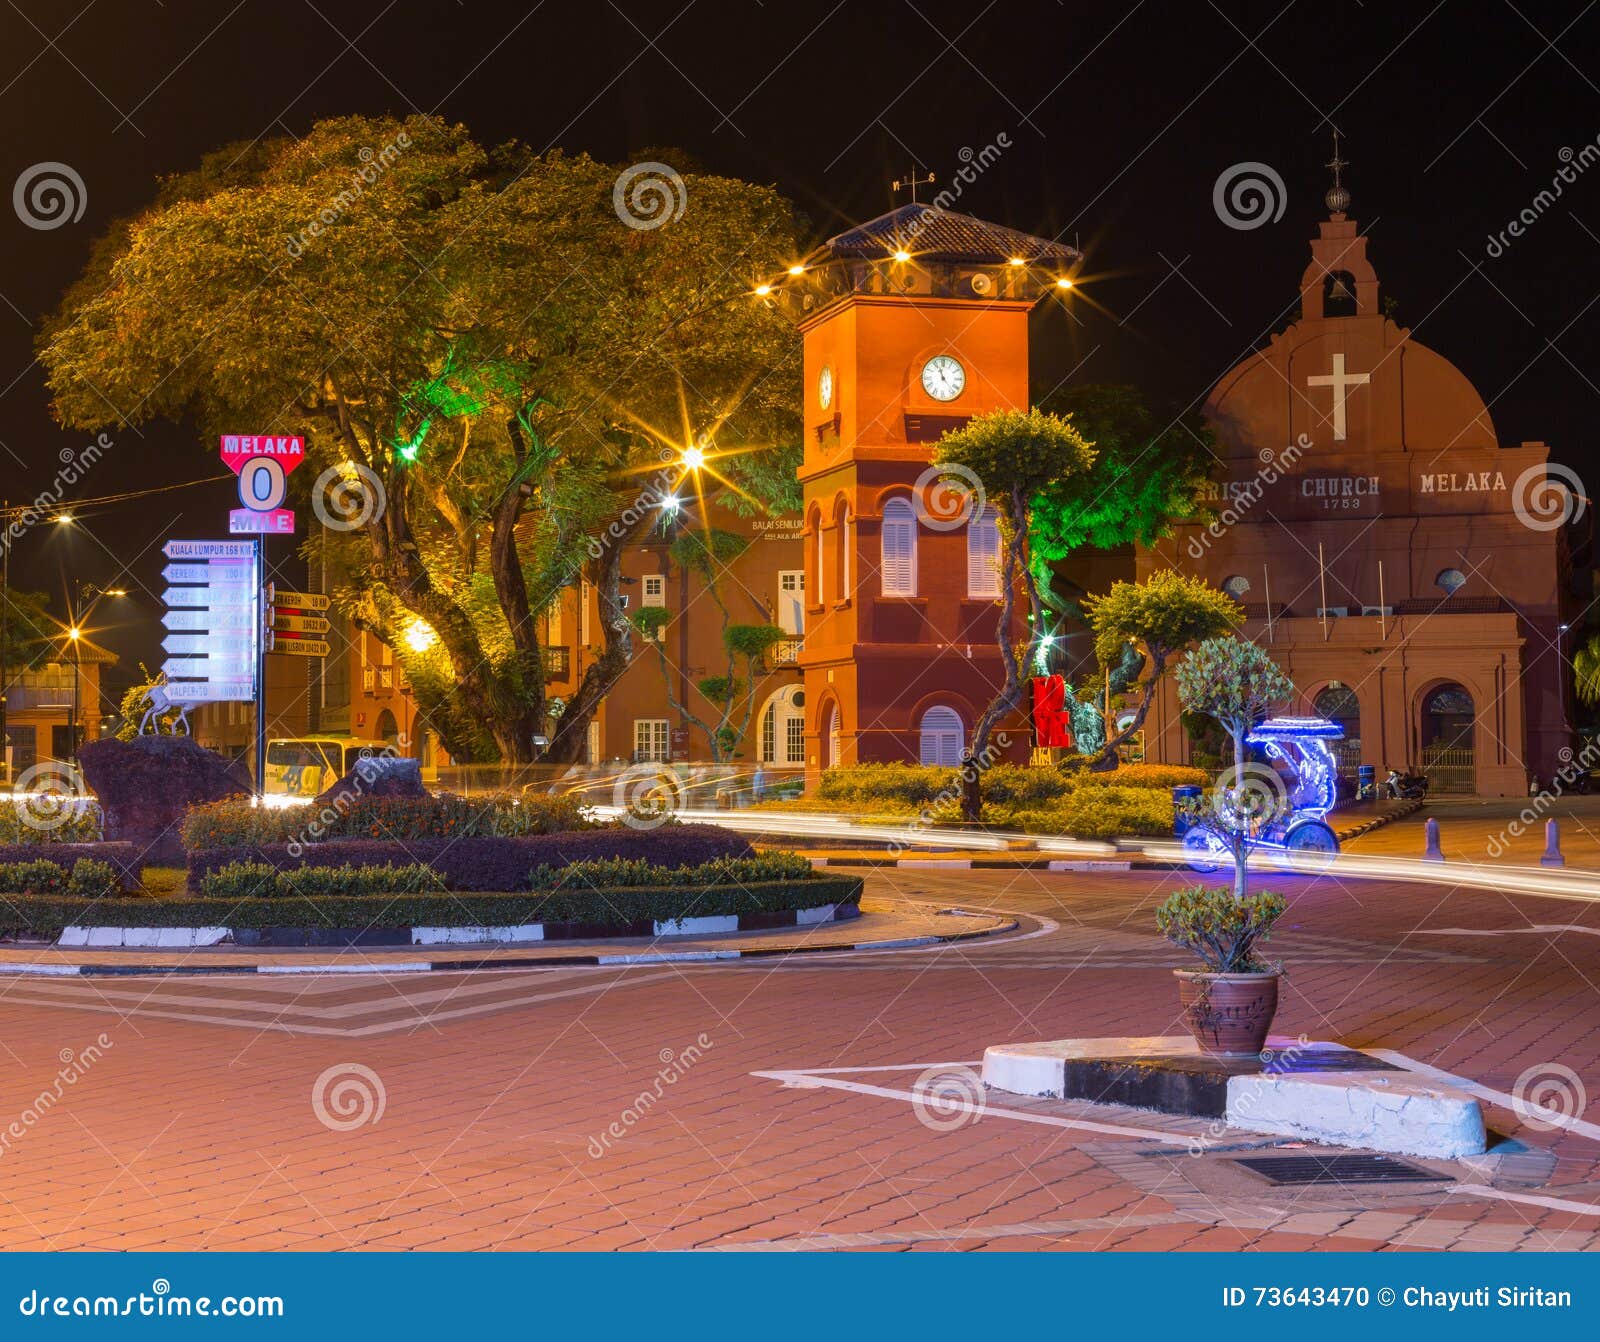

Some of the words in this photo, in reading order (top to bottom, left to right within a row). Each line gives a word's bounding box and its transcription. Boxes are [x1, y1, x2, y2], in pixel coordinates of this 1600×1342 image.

[224, 437, 301, 454] MELAKA
[1302, 477, 1380, 497] CHURCH
[1420, 472, 1507, 493] MELAKA
[234, 515, 289, 531] MILE
[170, 545, 193, 555] KUALA
[194, 545, 223, 555] LUMPUR
[240, 545, 251, 555] KM
